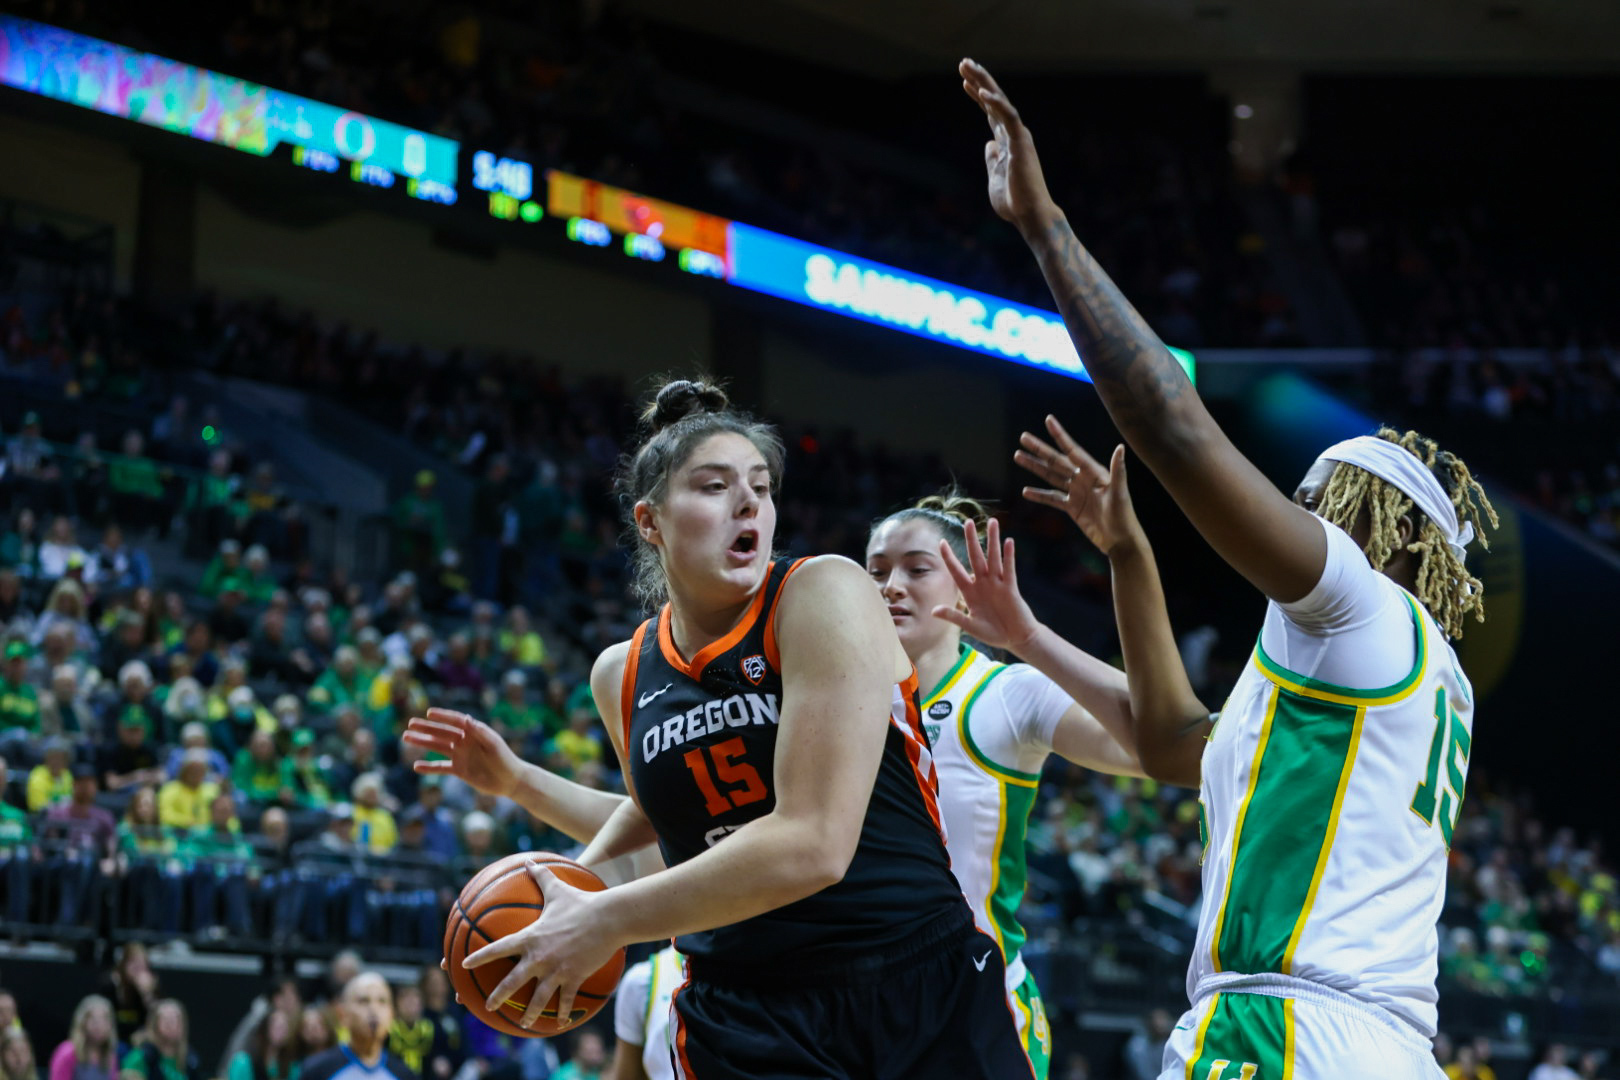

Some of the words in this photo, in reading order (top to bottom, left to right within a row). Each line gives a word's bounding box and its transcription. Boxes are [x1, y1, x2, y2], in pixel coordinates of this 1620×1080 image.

[643, 693, 781, 764] OREGON
[683, 736, 768, 817] 15
[1409, 685, 1472, 857] 15
